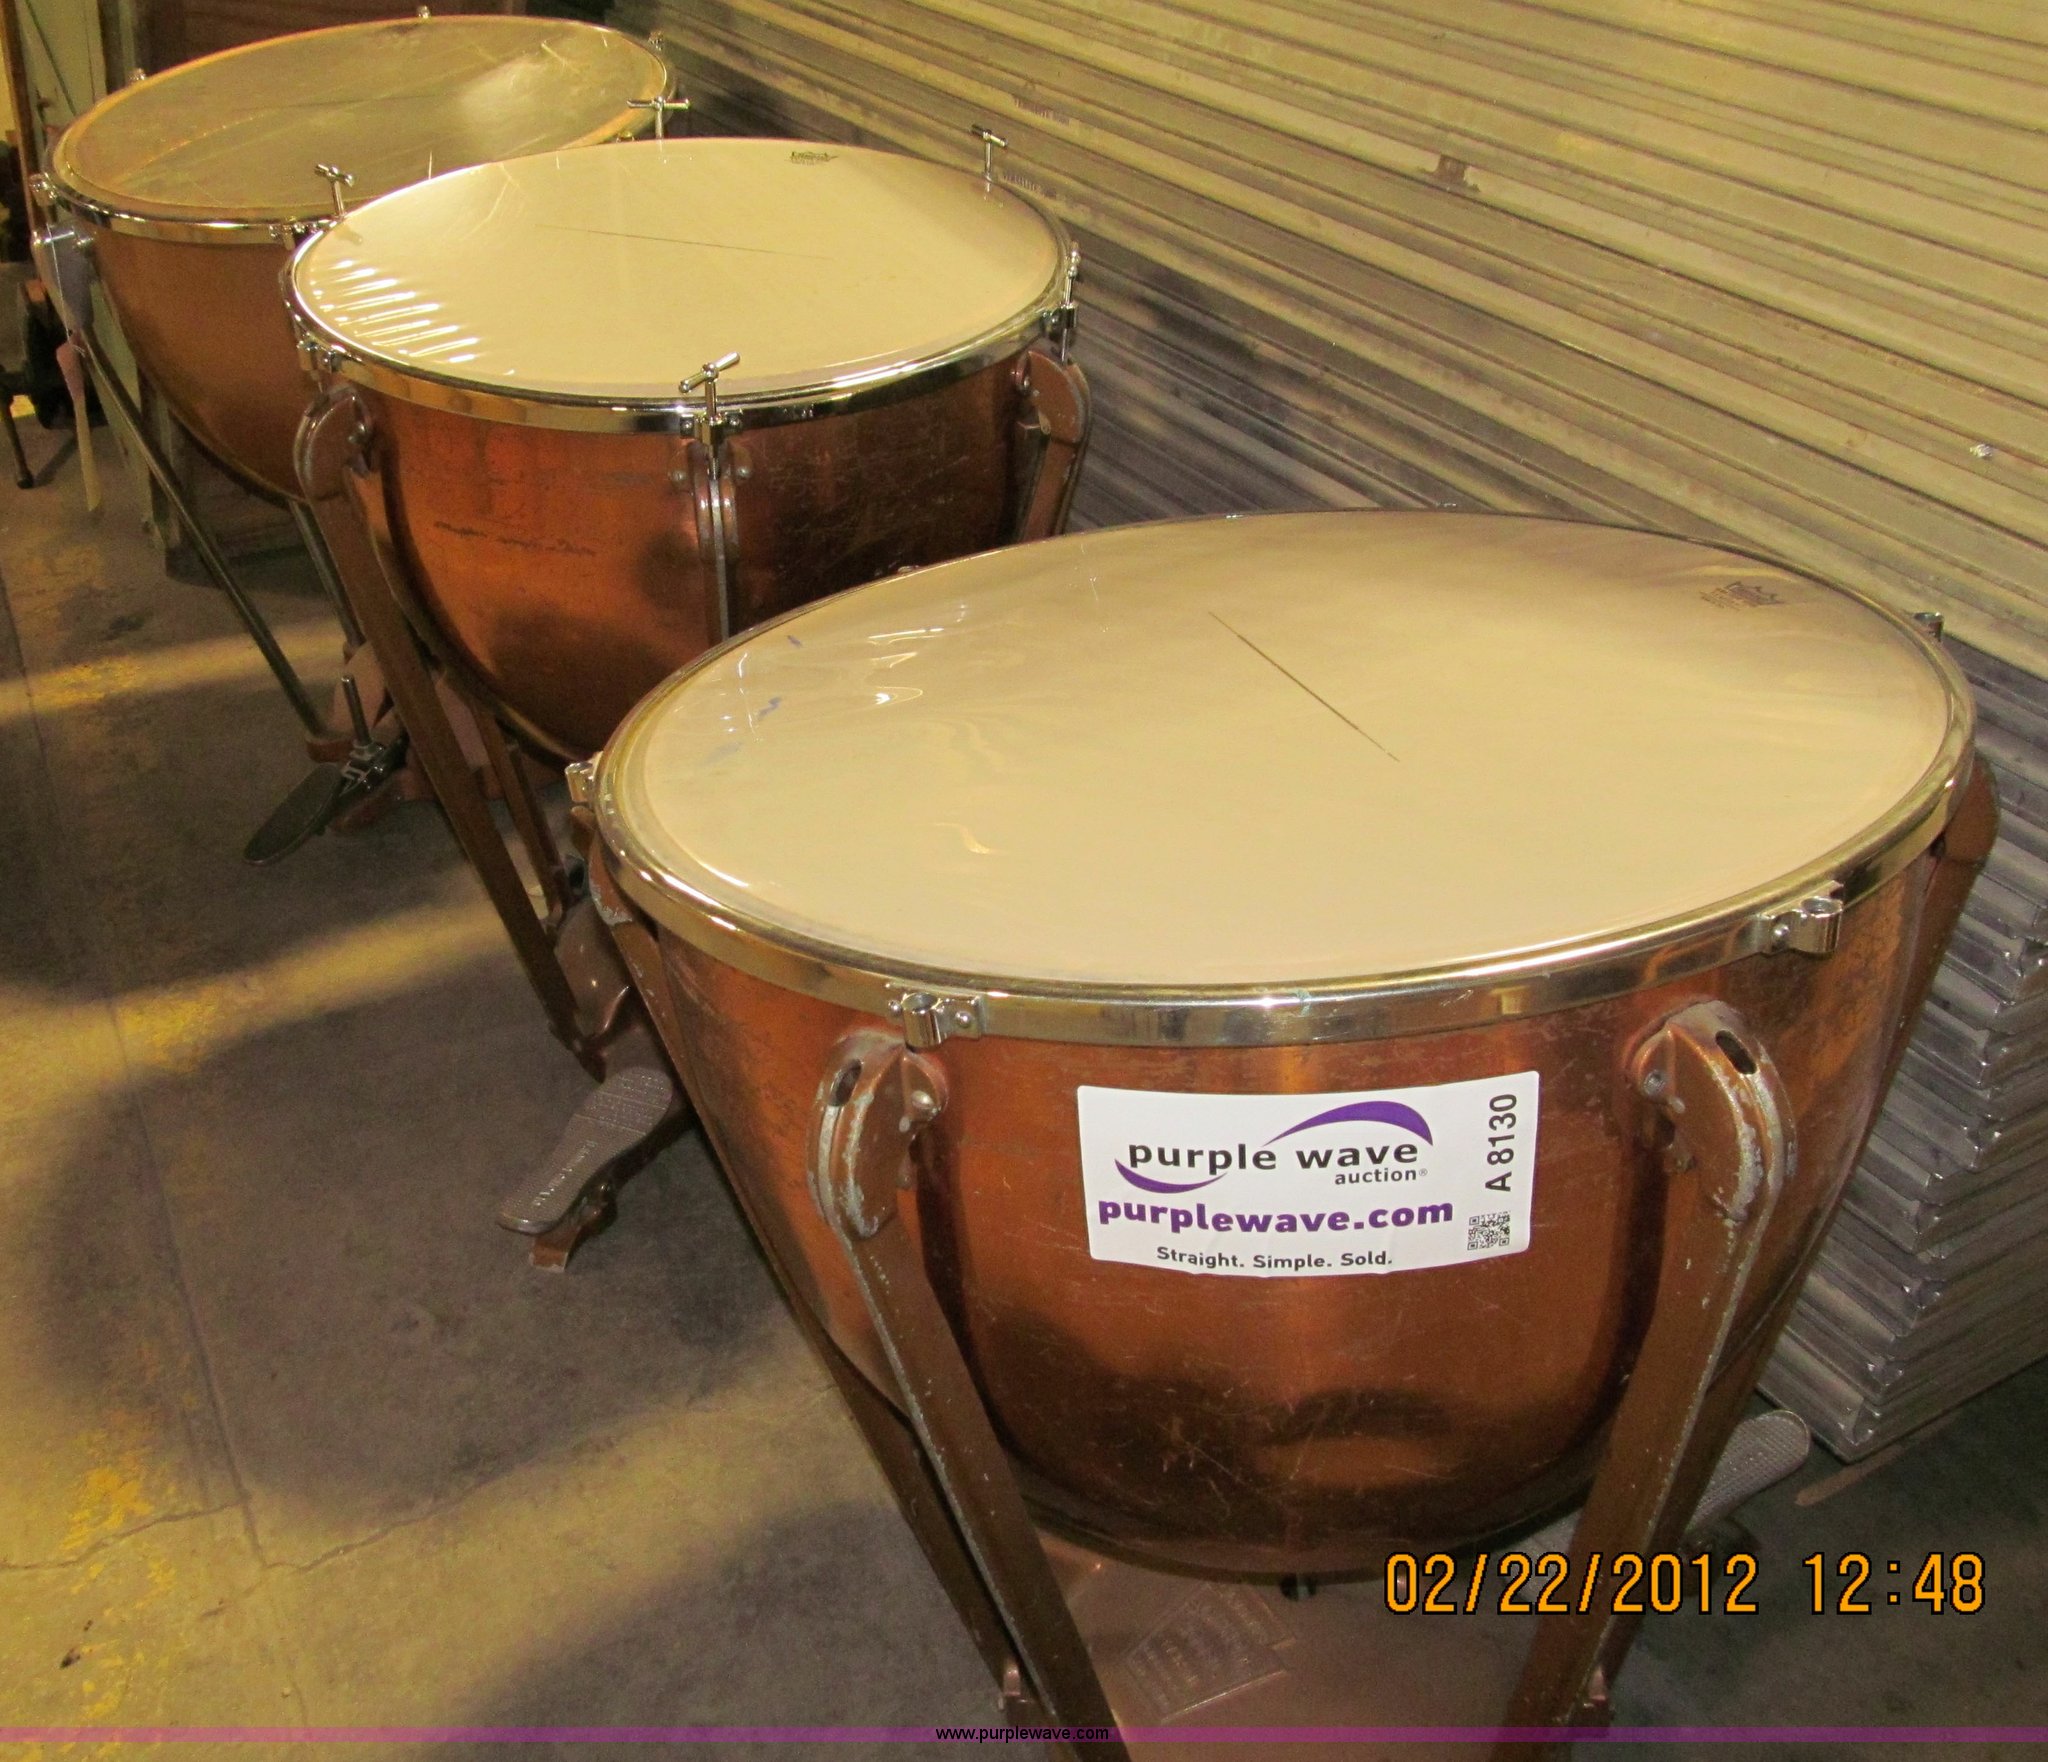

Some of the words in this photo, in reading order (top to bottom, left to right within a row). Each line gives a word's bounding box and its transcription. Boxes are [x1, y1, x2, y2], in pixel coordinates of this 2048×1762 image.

[1487, 1093, 1518, 1166] 8130
[1128, 1143, 1276, 1176] purple
[1296, 1141, 1419, 1169] wave
[1485, 1171, 1512, 1193] A
[1098, 1199, 1454, 1233] purplewave.com
[1156, 1246, 1245, 1268] Straight.
[1253, 1253, 1332, 1272] Simple.
[1340, 1249, 1393, 1267] Sold.
